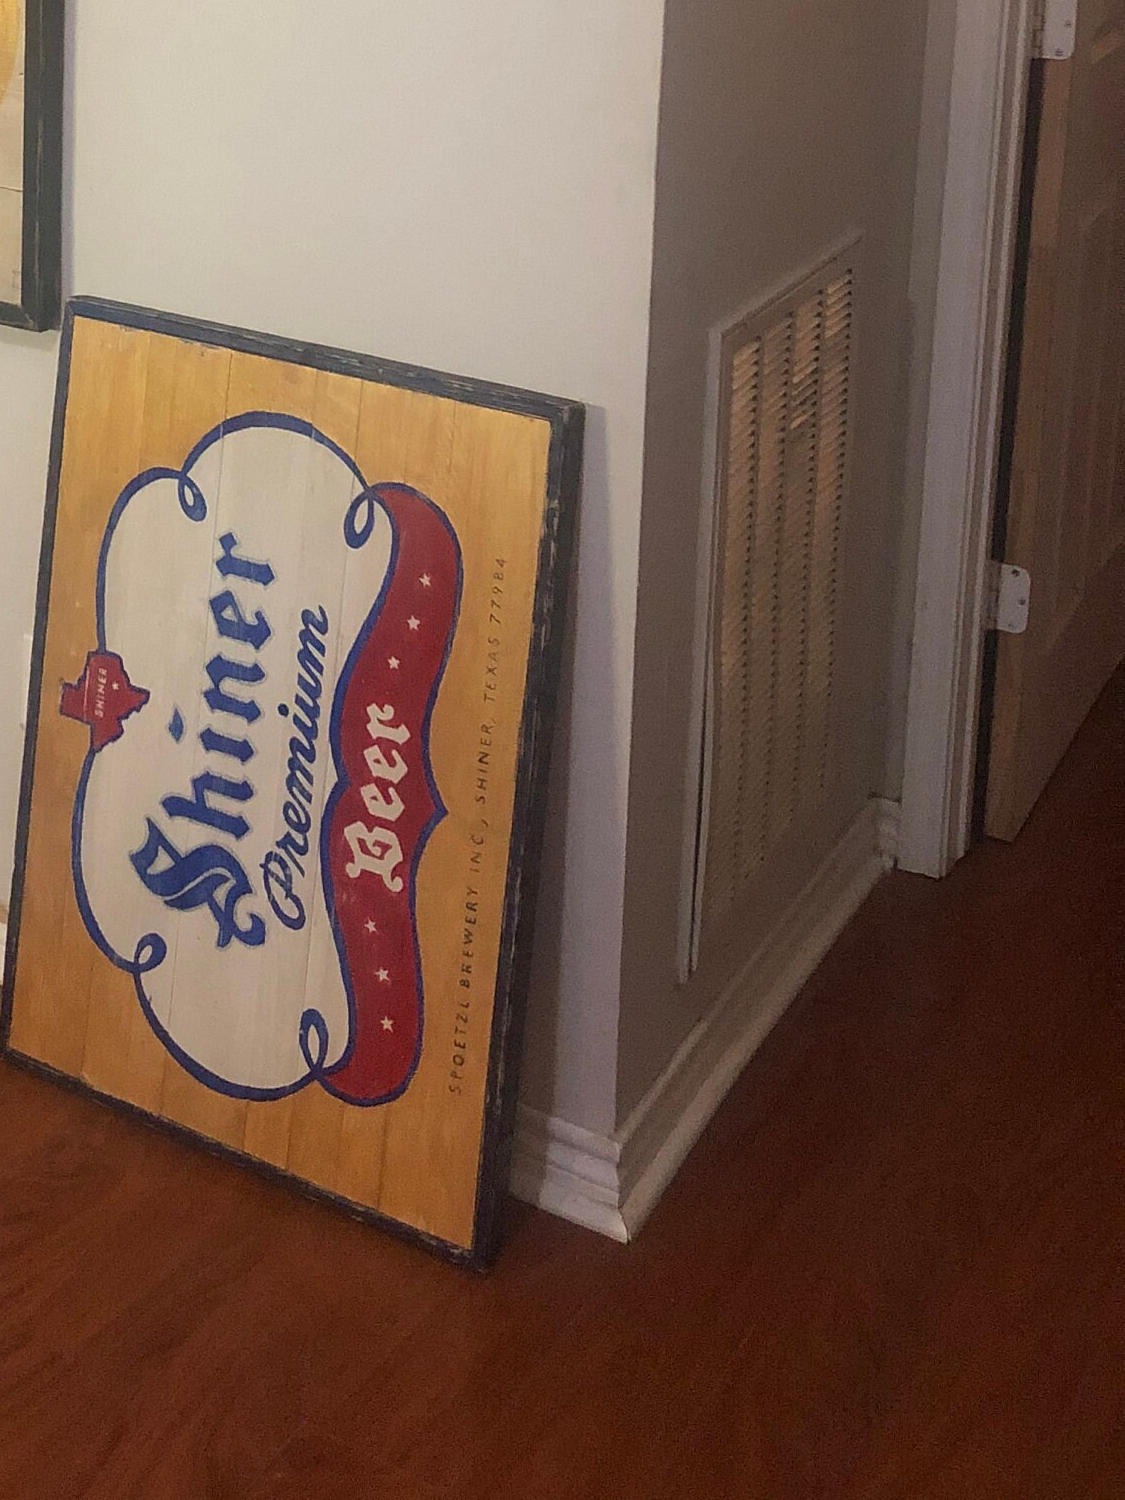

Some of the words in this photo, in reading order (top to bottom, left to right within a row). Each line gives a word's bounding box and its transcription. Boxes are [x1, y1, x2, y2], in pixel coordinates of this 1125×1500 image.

[94, 667, 108, 718] SHINER
[129, 531, 275, 948] Shiner
[260, 605, 328, 931] Premium
[344, 703, 411, 892] Beer
[448, 1002, 470, 1095] SPOETZL
[459, 887, 478, 989] BREWERY
[483, 637, 501, 703] TEXAS
